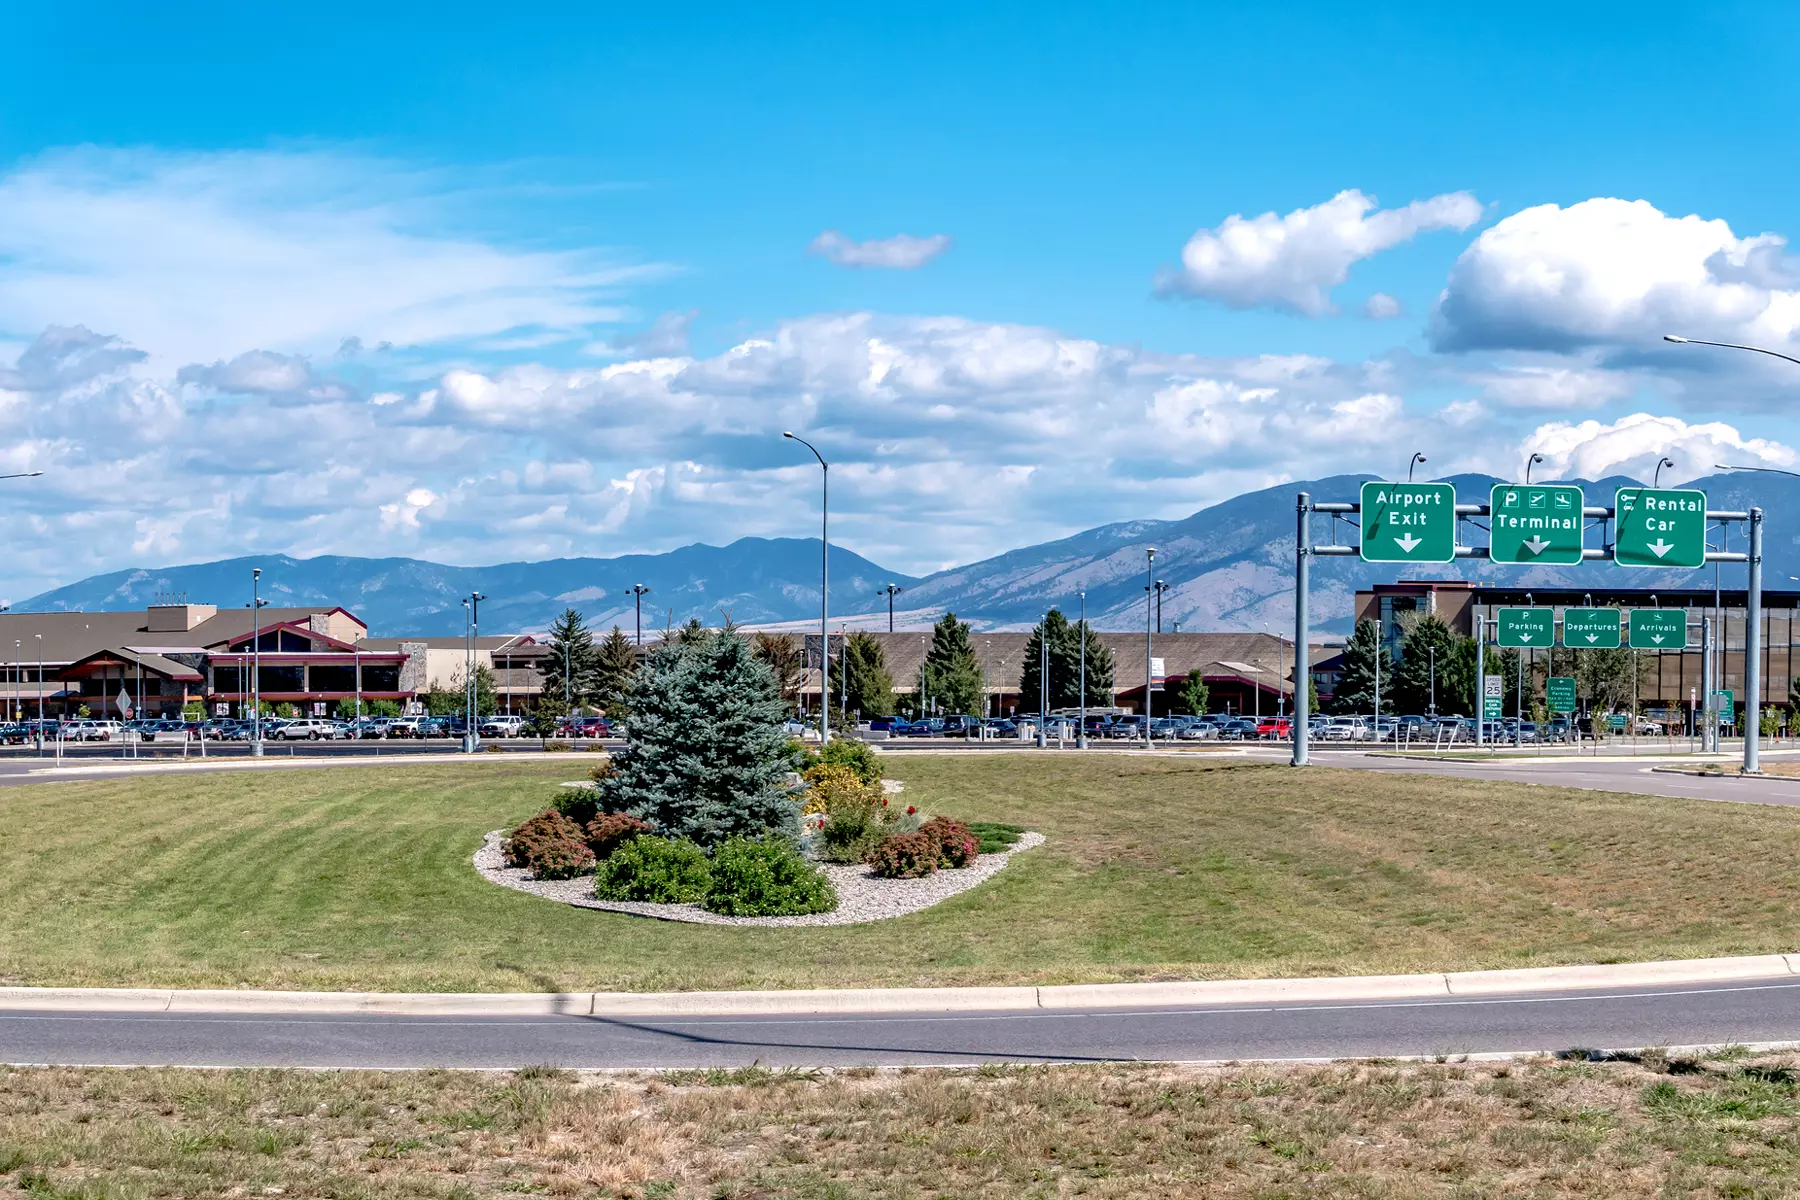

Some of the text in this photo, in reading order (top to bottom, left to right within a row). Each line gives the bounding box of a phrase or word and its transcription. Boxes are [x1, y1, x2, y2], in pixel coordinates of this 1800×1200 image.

[1376, 490, 1441, 508] Airport
[1645, 497, 1702, 512] Rental
[1389, 511, 1427, 525] Exit
[1497, 514, 1577, 530] Terminal
[1645, 517, 1676, 531] Car
[1508, 622, 1544, 632] Parking
[1567, 623, 1617, 632] Departures
[1639, 624, 1677, 632] Arrivals
[1486, 686, 1501, 695] 25
